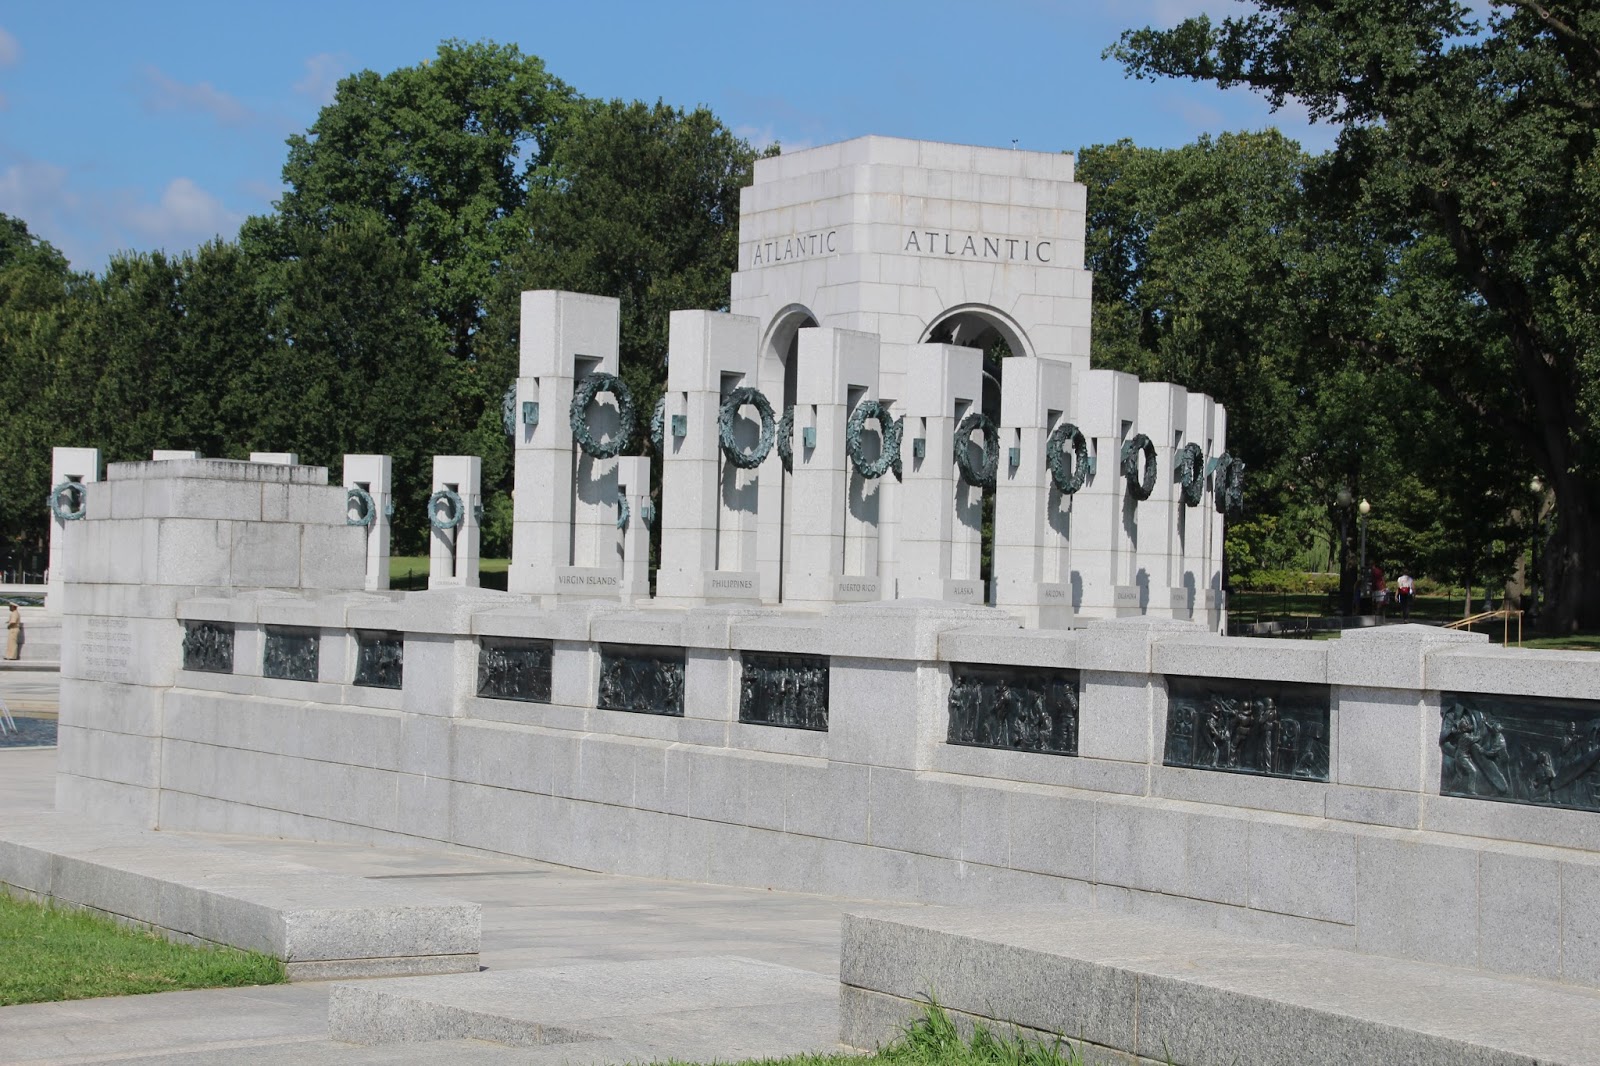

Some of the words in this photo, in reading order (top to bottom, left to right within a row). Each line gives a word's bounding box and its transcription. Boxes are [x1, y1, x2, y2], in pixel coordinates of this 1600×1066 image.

[753, 231, 837, 265] ATLANTIC
[904, 230, 1051, 263] ATLANTIC
[558, 575, 584, 584] VIRGIN
[586, 576, 617, 585] ISLANDS
[712, 579, 752, 588] PHILIPPINES
[839, 583, 861, 592] PUERTO
[862, 584, 876, 592] RICO
[953, 587, 974, 595] ALASKA
